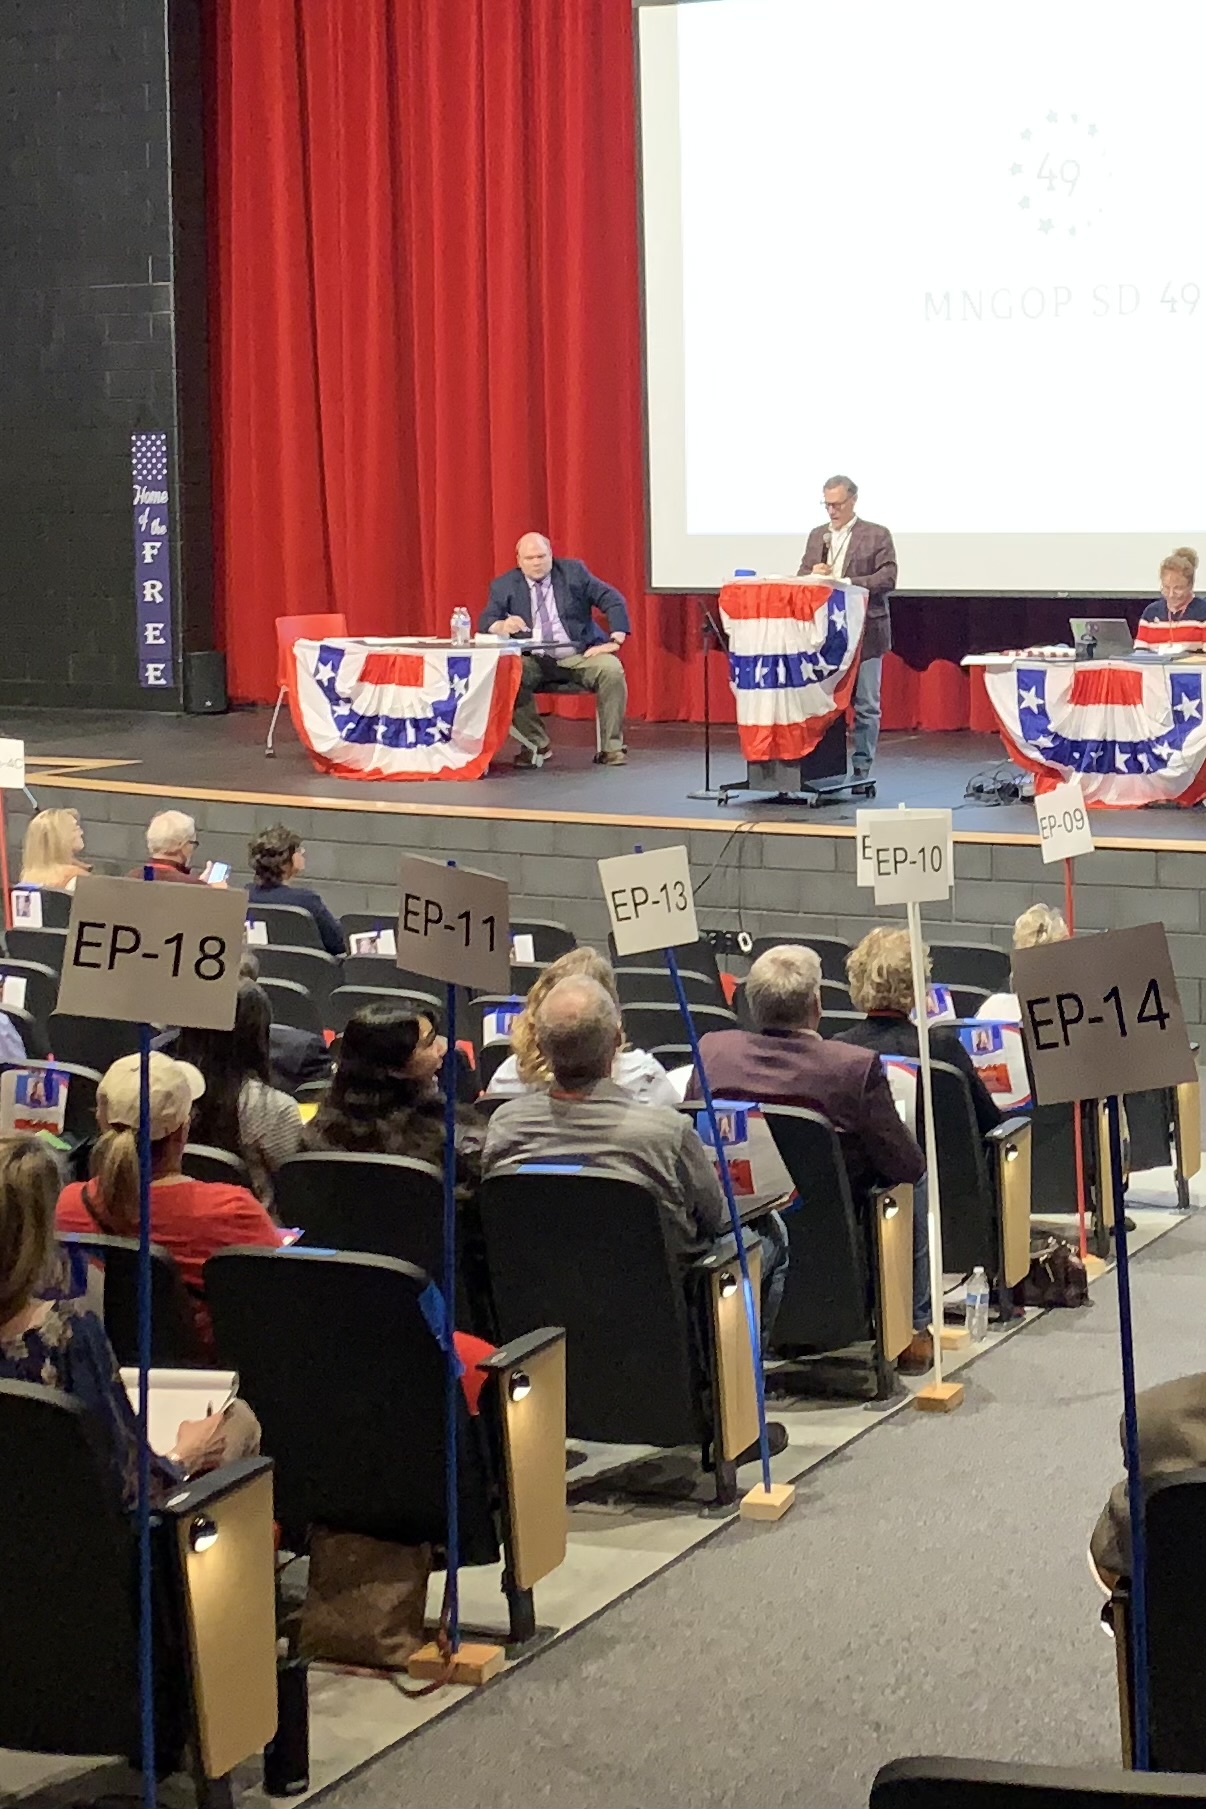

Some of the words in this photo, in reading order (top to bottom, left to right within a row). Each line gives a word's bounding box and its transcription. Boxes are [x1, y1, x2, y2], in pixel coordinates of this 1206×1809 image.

[1036, 152, 1080, 196] 49
[923, 285, 1072, 322] MNGOP
[1091, 283, 1140, 317] SD
[1159, 280, 1200, 315] 49
[132, 484, 169, 506] Home
[142, 541, 167, 685] FREE
[1039, 807, 1085, 840] EP-09
[876, 845, 942, 876] EP-10
[403, 893, 496, 952] EP-11
[611, 881, 689, 922] EP-13
[72, 920, 226, 981] EP-18
[1026, 978, 1170, 1050] EP-14
